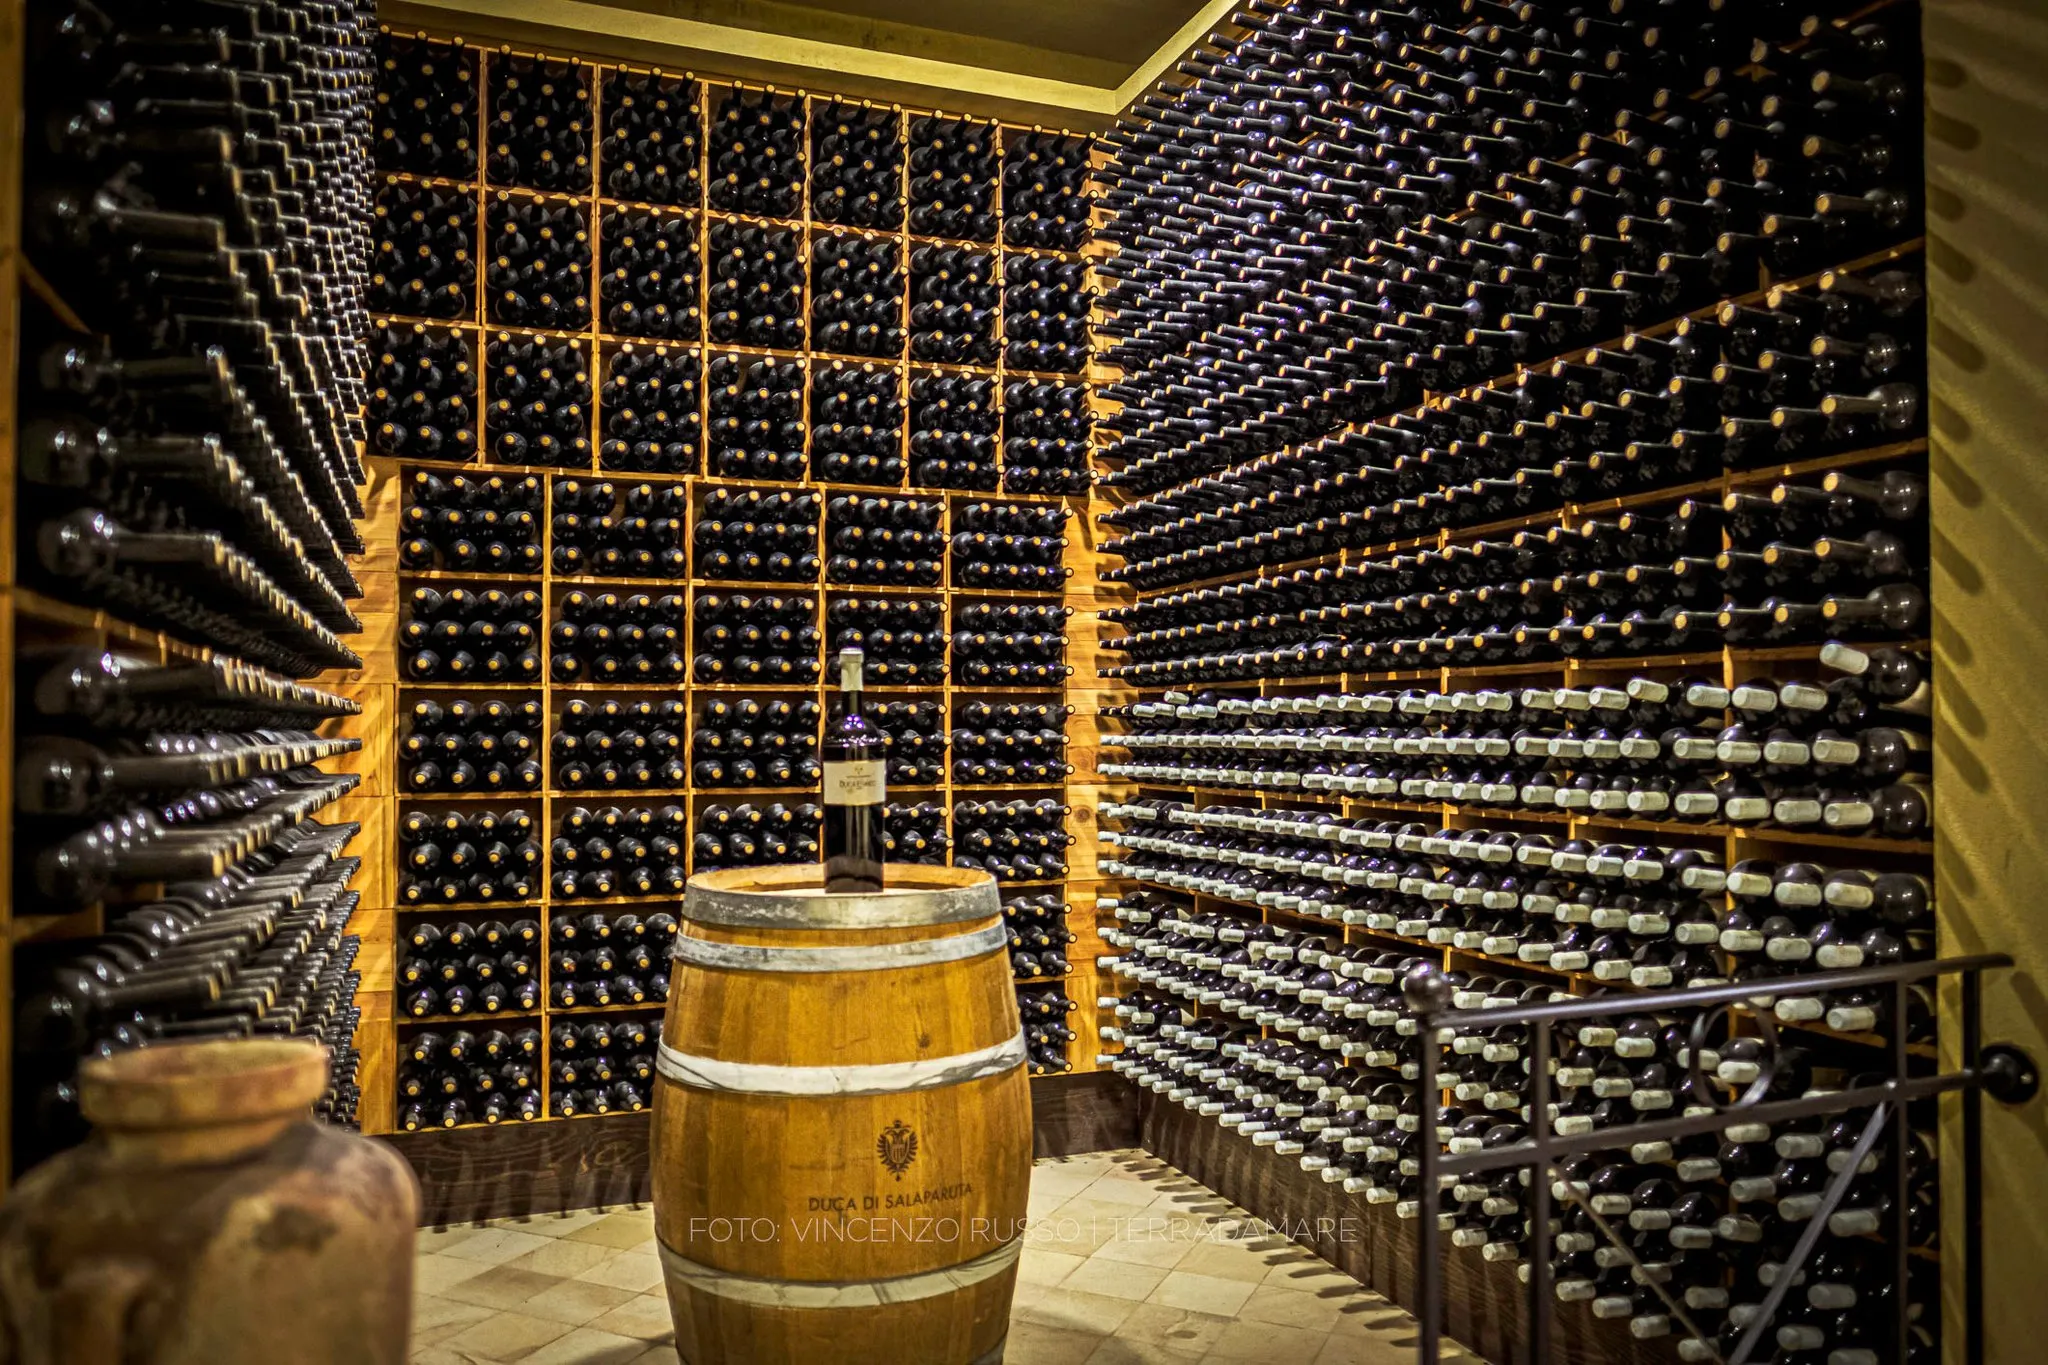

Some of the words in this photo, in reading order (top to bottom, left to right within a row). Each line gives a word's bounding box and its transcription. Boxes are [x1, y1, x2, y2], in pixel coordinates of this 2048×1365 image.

[808, 1197, 858, 1211] DUCA
[863, 1196, 879, 1210] DI
[885, 1183, 973, 1209] SALAPARUTA
